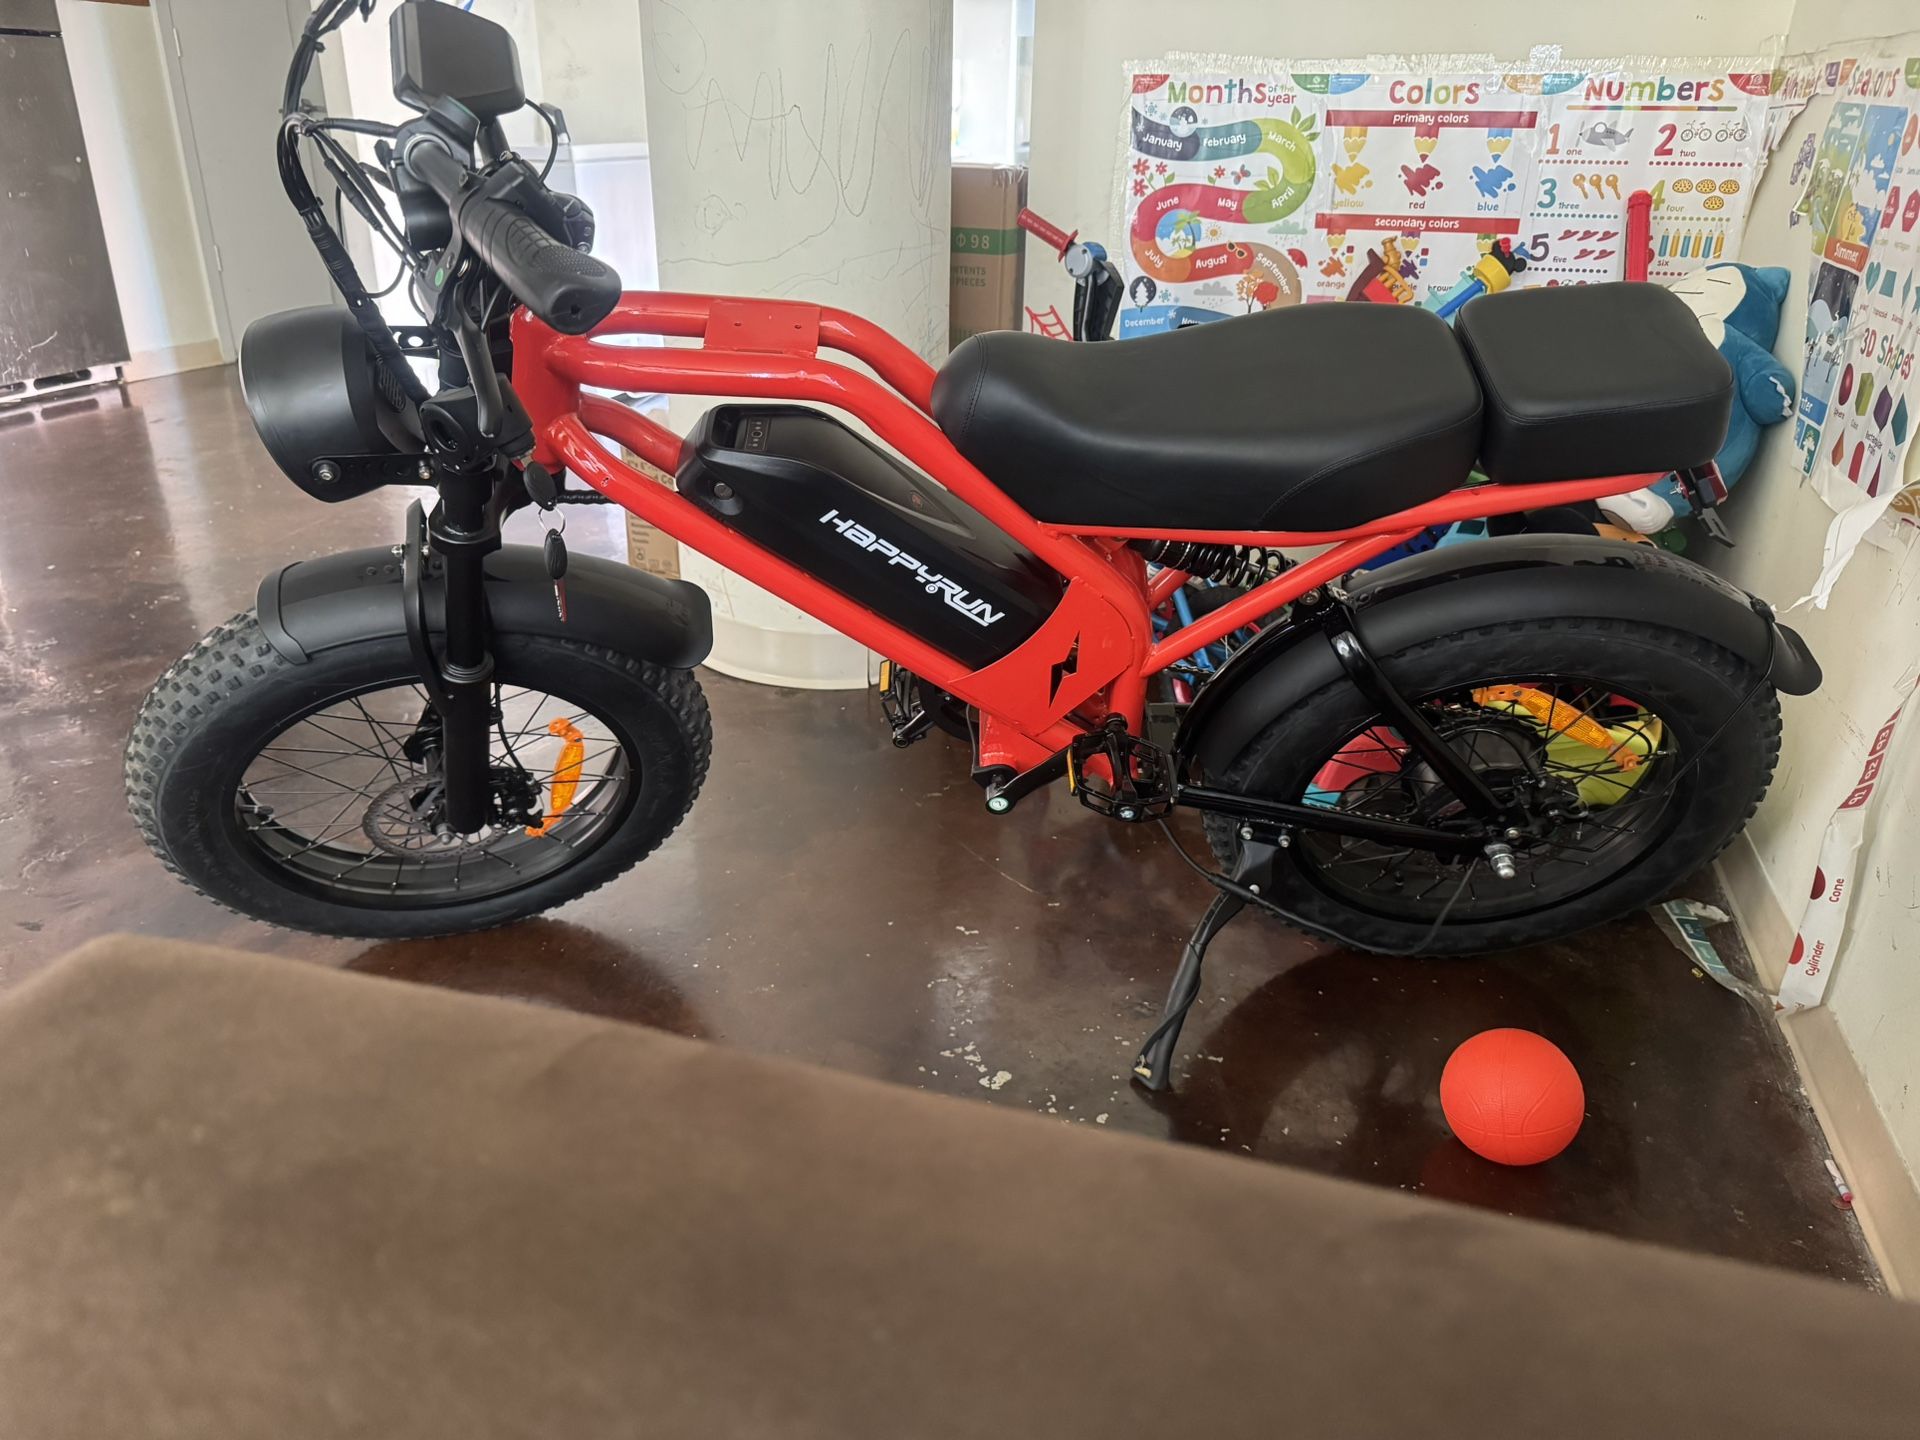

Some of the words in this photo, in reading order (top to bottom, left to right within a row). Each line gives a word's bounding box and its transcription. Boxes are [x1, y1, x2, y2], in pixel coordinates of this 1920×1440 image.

[1167, 79, 1266, 104] Months
[1268, 84, 1278, 93] of
[1279, 83, 1294, 92] the
[1389, 78, 1480, 104] Colors
[1584, 76, 1725, 101] Numbers
[1268, 93, 1296, 107] year
[1393, 113, 1435, 125] primary
[1438, 113, 1469, 123] colors
[1142, 132, 1183, 151] January
[1203, 133, 1246, 148] February
[1268, 131, 1296, 152] March
[1546, 123, 1560, 155] 1
[1566, 148, 1582, 156] one
[1654, 123, 1677, 157] 2
[1680, 150, 1696, 158] two
[1155, 196, 1179, 210] June
[1271, 187, 1295, 209] April
[1537, 178, 1557, 209] 3
[1558, 202, 1580, 210] three
[1217, 197, 1237, 210] May
[1332, 199, 1364, 210] yellow
[1408, 201, 1425, 210] red
[1477, 202, 1499, 212] blue
[1666, 205, 1684, 213] four
[1375, 218, 1426, 230] secondary
[1429, 219, 1460, 229] colors
[1530, 233, 1550, 261] 5
[1144, 248, 1164, 268] July
[1195, 255, 1228, 269] August
[1657, 259, 1669, 267] six
[1255, 253, 1292, 296] September
[1316, 280, 1346, 289] orange
[1124, 317, 1164, 328] December
[1860, 327, 1877, 358] 3D
[1801, 397, 1813, 414] nter
[1829, 878, 1844, 903] Cone
[1805, 939, 1826, 976] Cylinder
